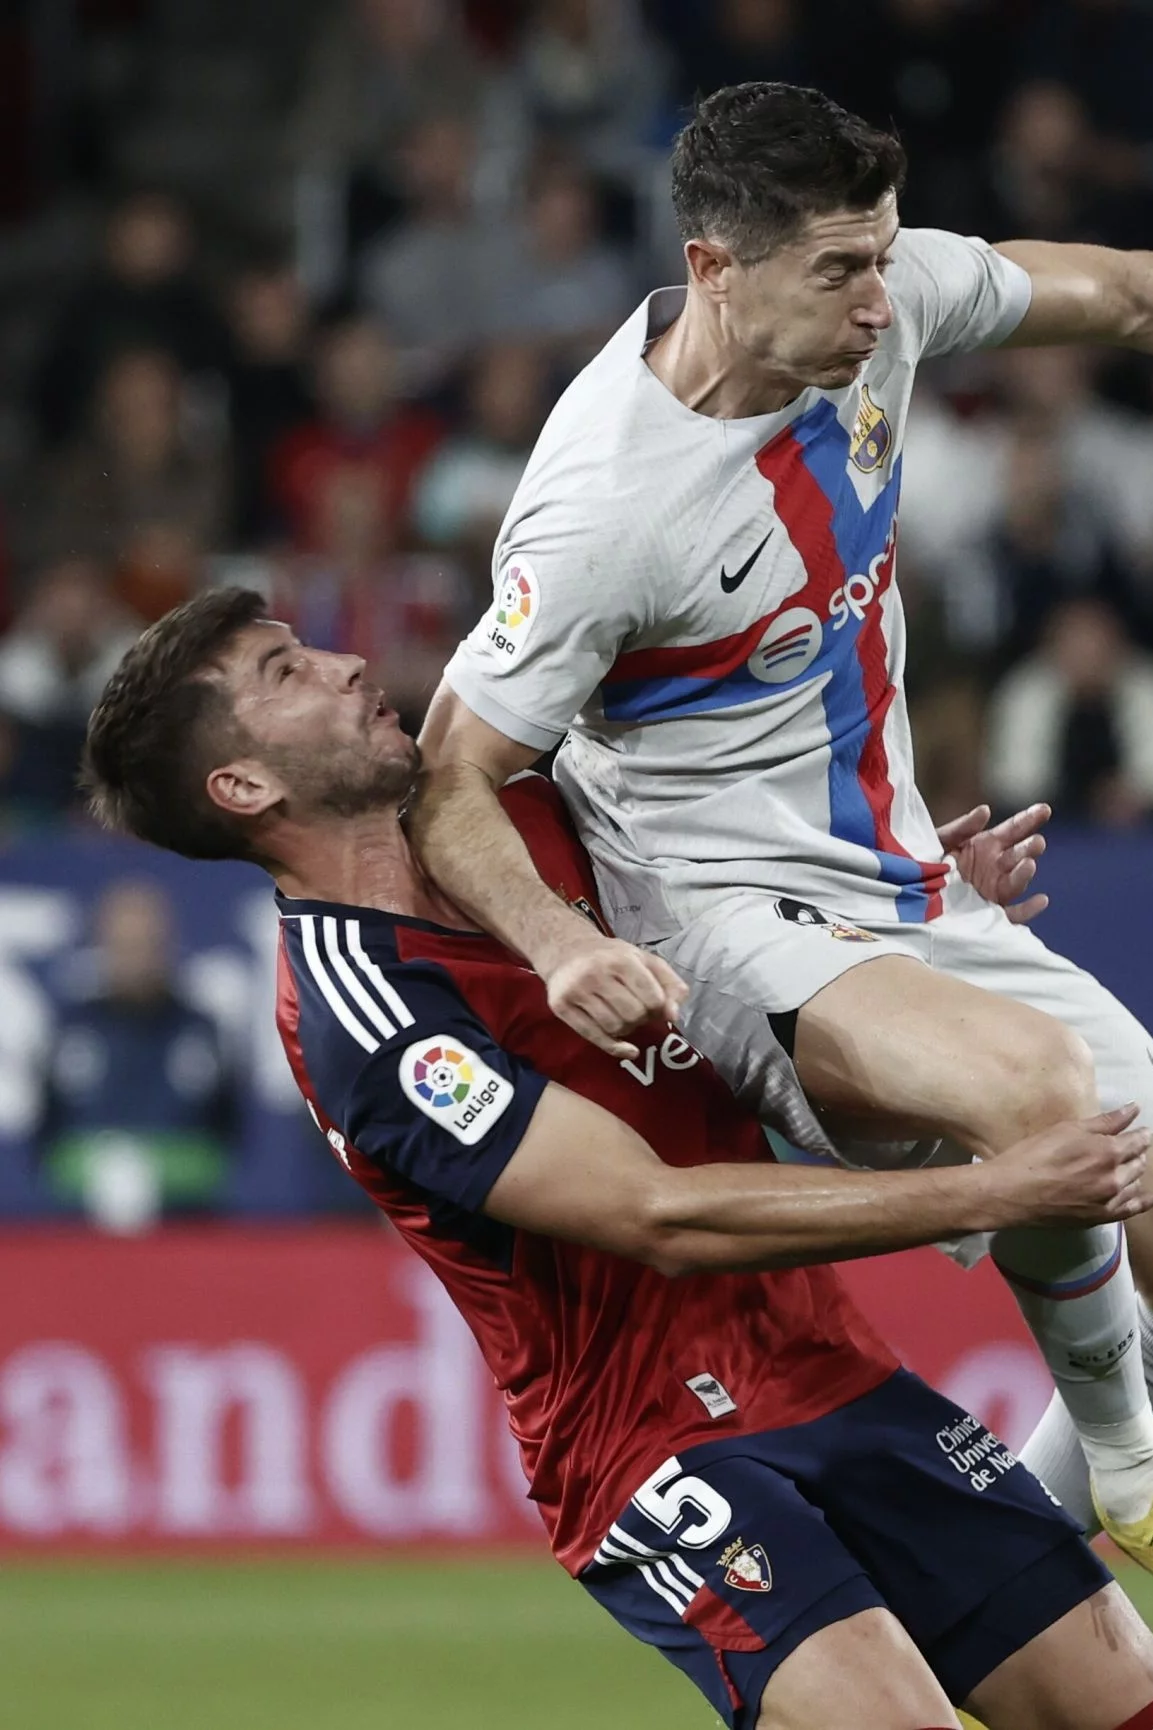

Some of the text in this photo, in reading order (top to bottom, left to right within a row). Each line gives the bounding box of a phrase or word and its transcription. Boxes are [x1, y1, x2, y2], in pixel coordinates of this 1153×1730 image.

[828, 551, 890, 631] spo
[486, 627, 516, 656] iga
[620, 1031, 704, 1087] ve
[453, 1079, 500, 1131] LaLiga
[0, 1253, 545, 1537] and
[631, 1455, 732, 1549] 5
[970, 1468, 997, 1492] de
